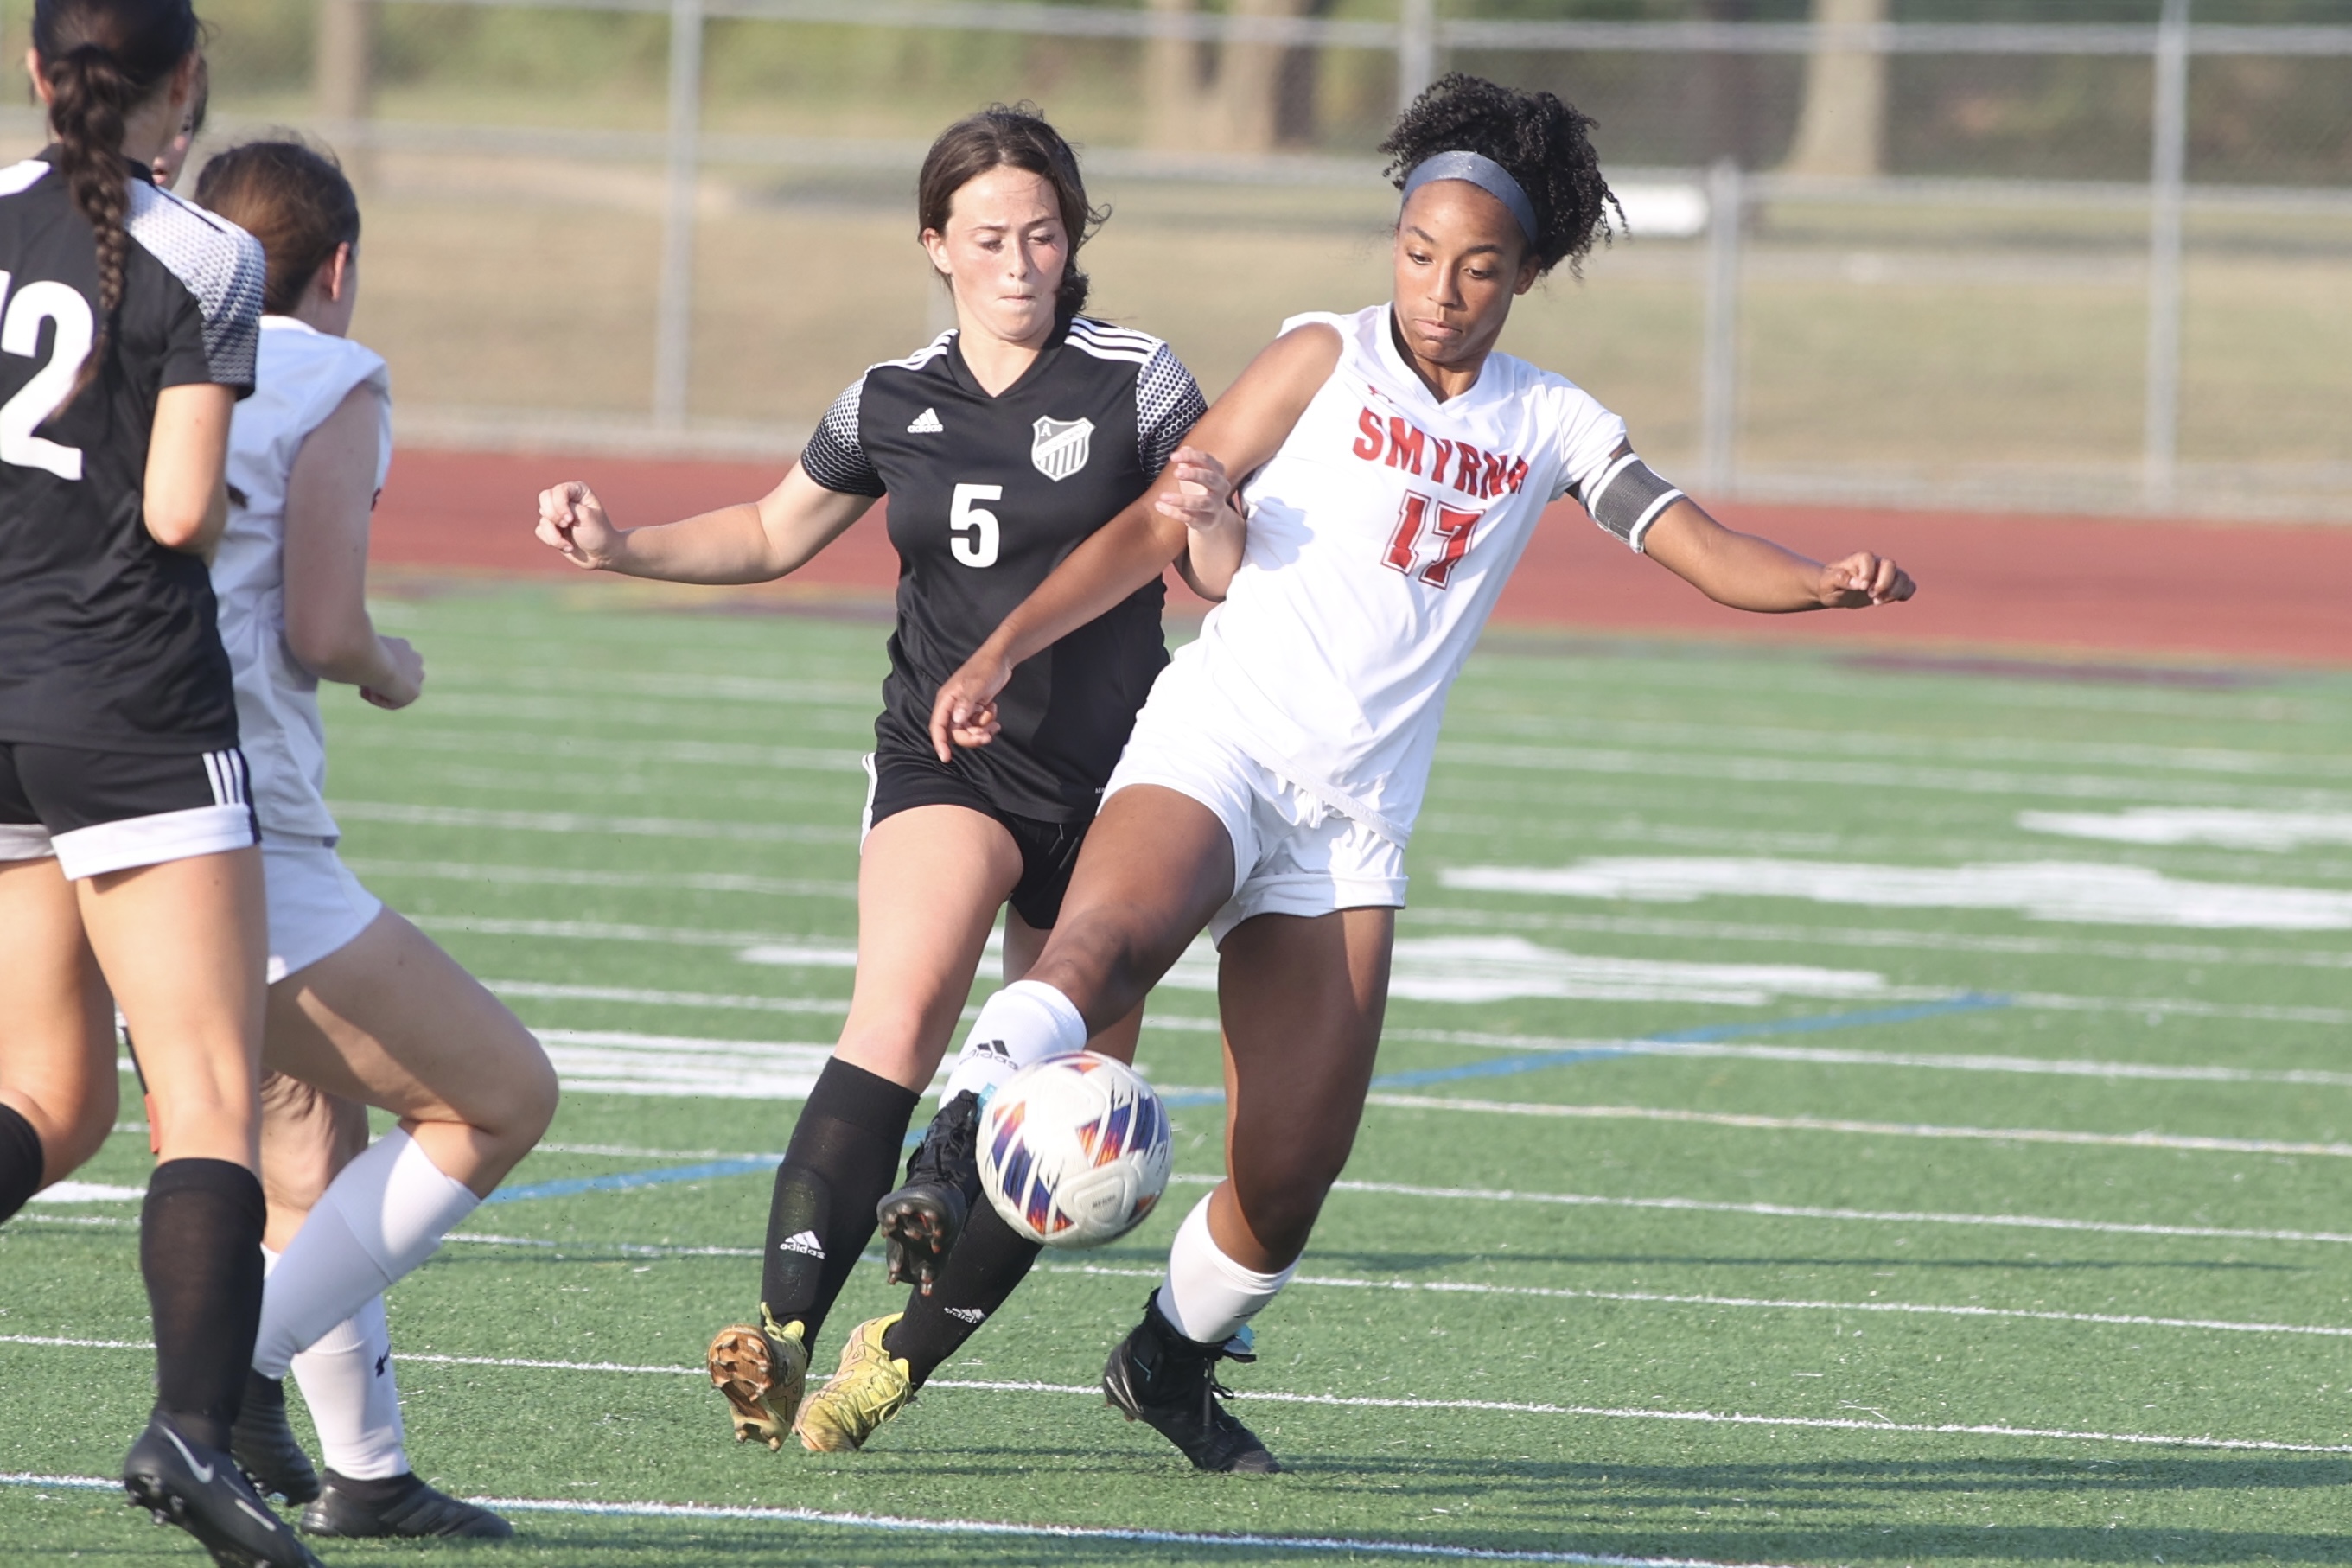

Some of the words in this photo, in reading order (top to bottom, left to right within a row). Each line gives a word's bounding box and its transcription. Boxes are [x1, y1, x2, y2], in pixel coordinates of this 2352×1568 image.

[0, 270, 94, 481] 2
[907, 424, 944, 434] adidas
[1040, 423, 1052, 437] A
[1353, 406, 1529, 500] SMYRNA
[950, 483, 1003, 568] 5
[1380, 488, 1486, 590] 17
[780, 1243, 825, 1259] adidas
